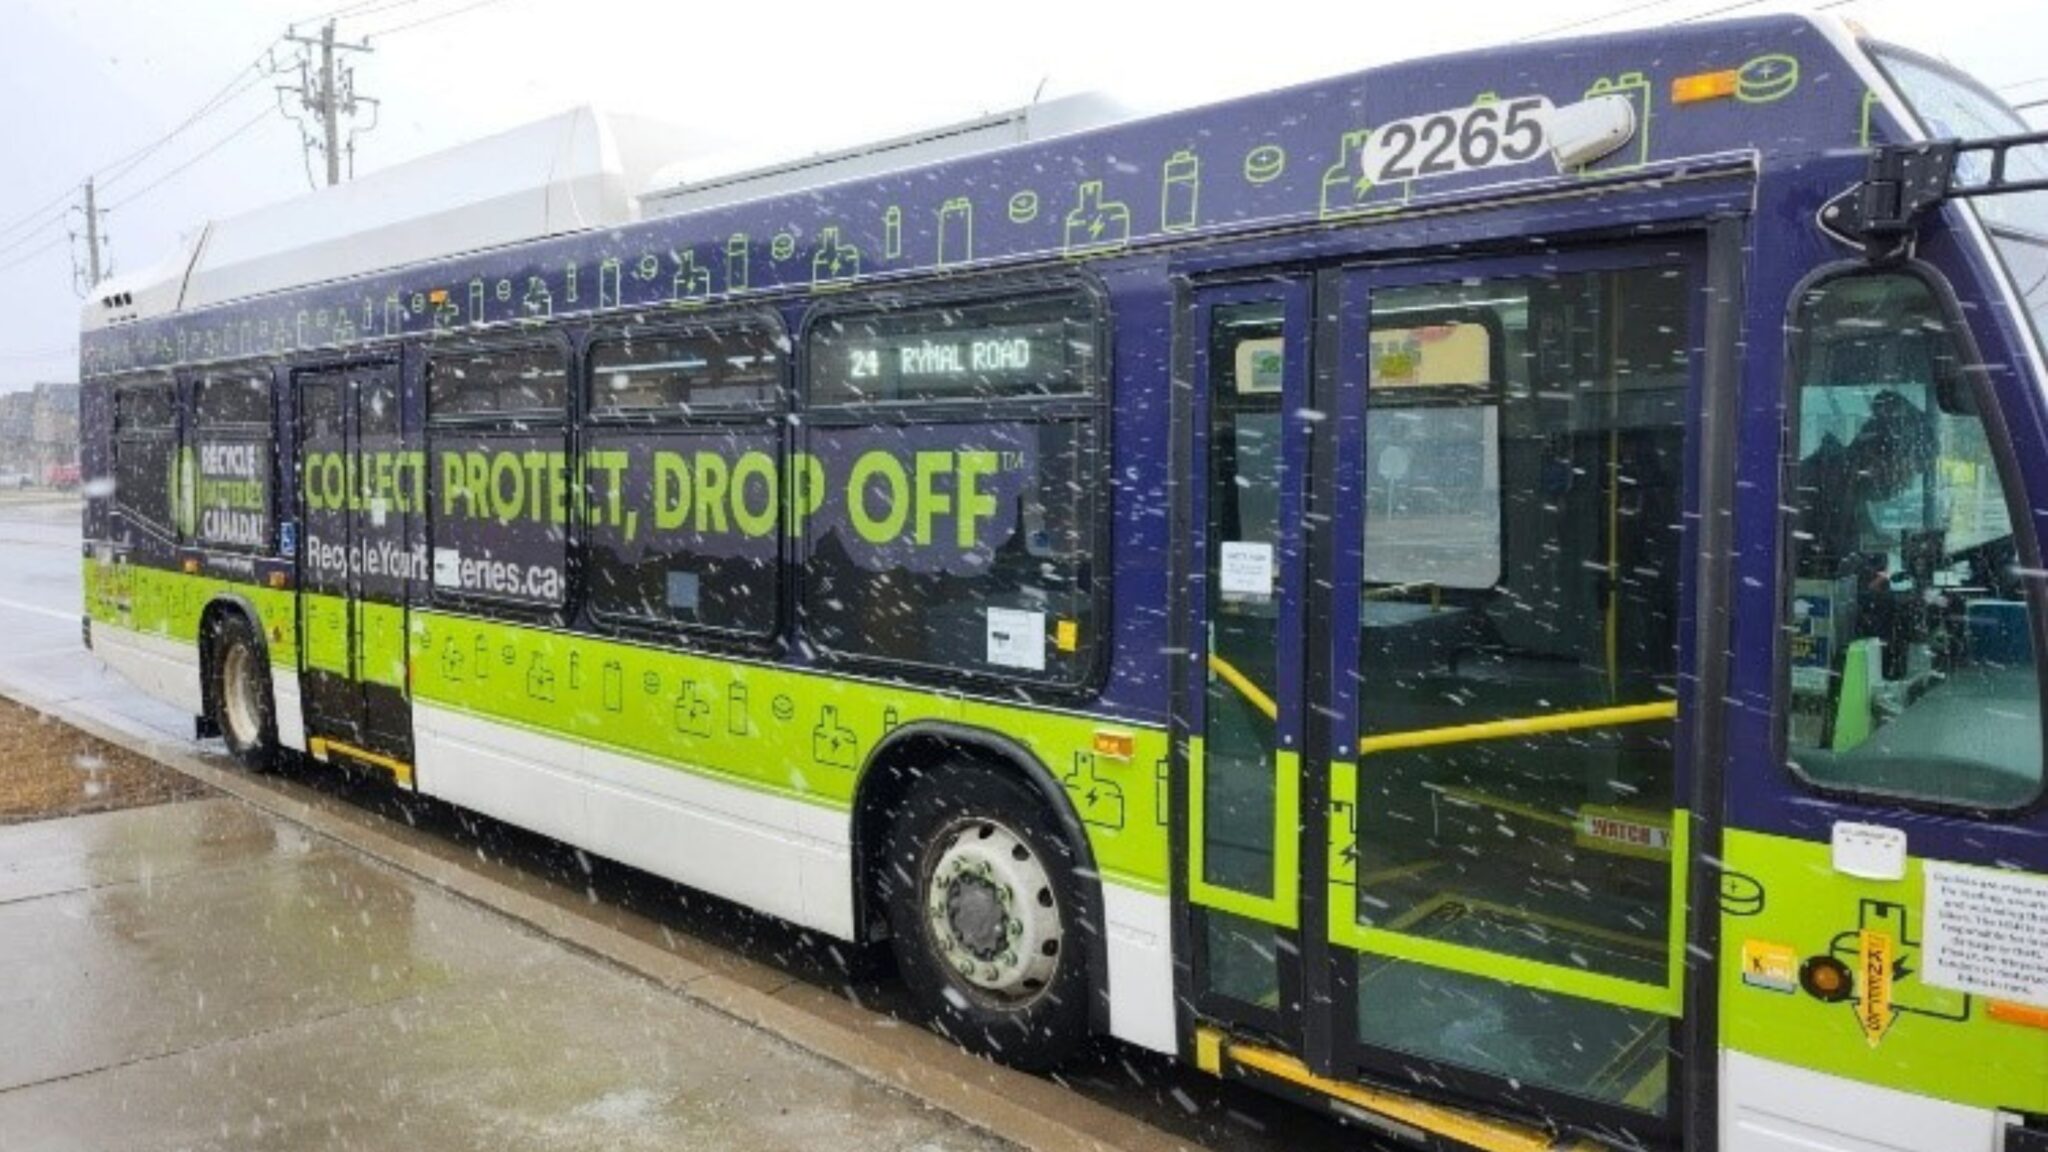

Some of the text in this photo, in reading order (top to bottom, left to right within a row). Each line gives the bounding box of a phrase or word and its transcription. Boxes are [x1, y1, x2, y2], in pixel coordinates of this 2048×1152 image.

[1379, 99, 1543, 180] 2265
[850, 338, 1030, 377] 24 RYMAL ROAD
[443, 451, 638, 541] PROTECT,
[653, 451, 826, 538] DROP
[1591, 816, 1650, 845] WATCH
